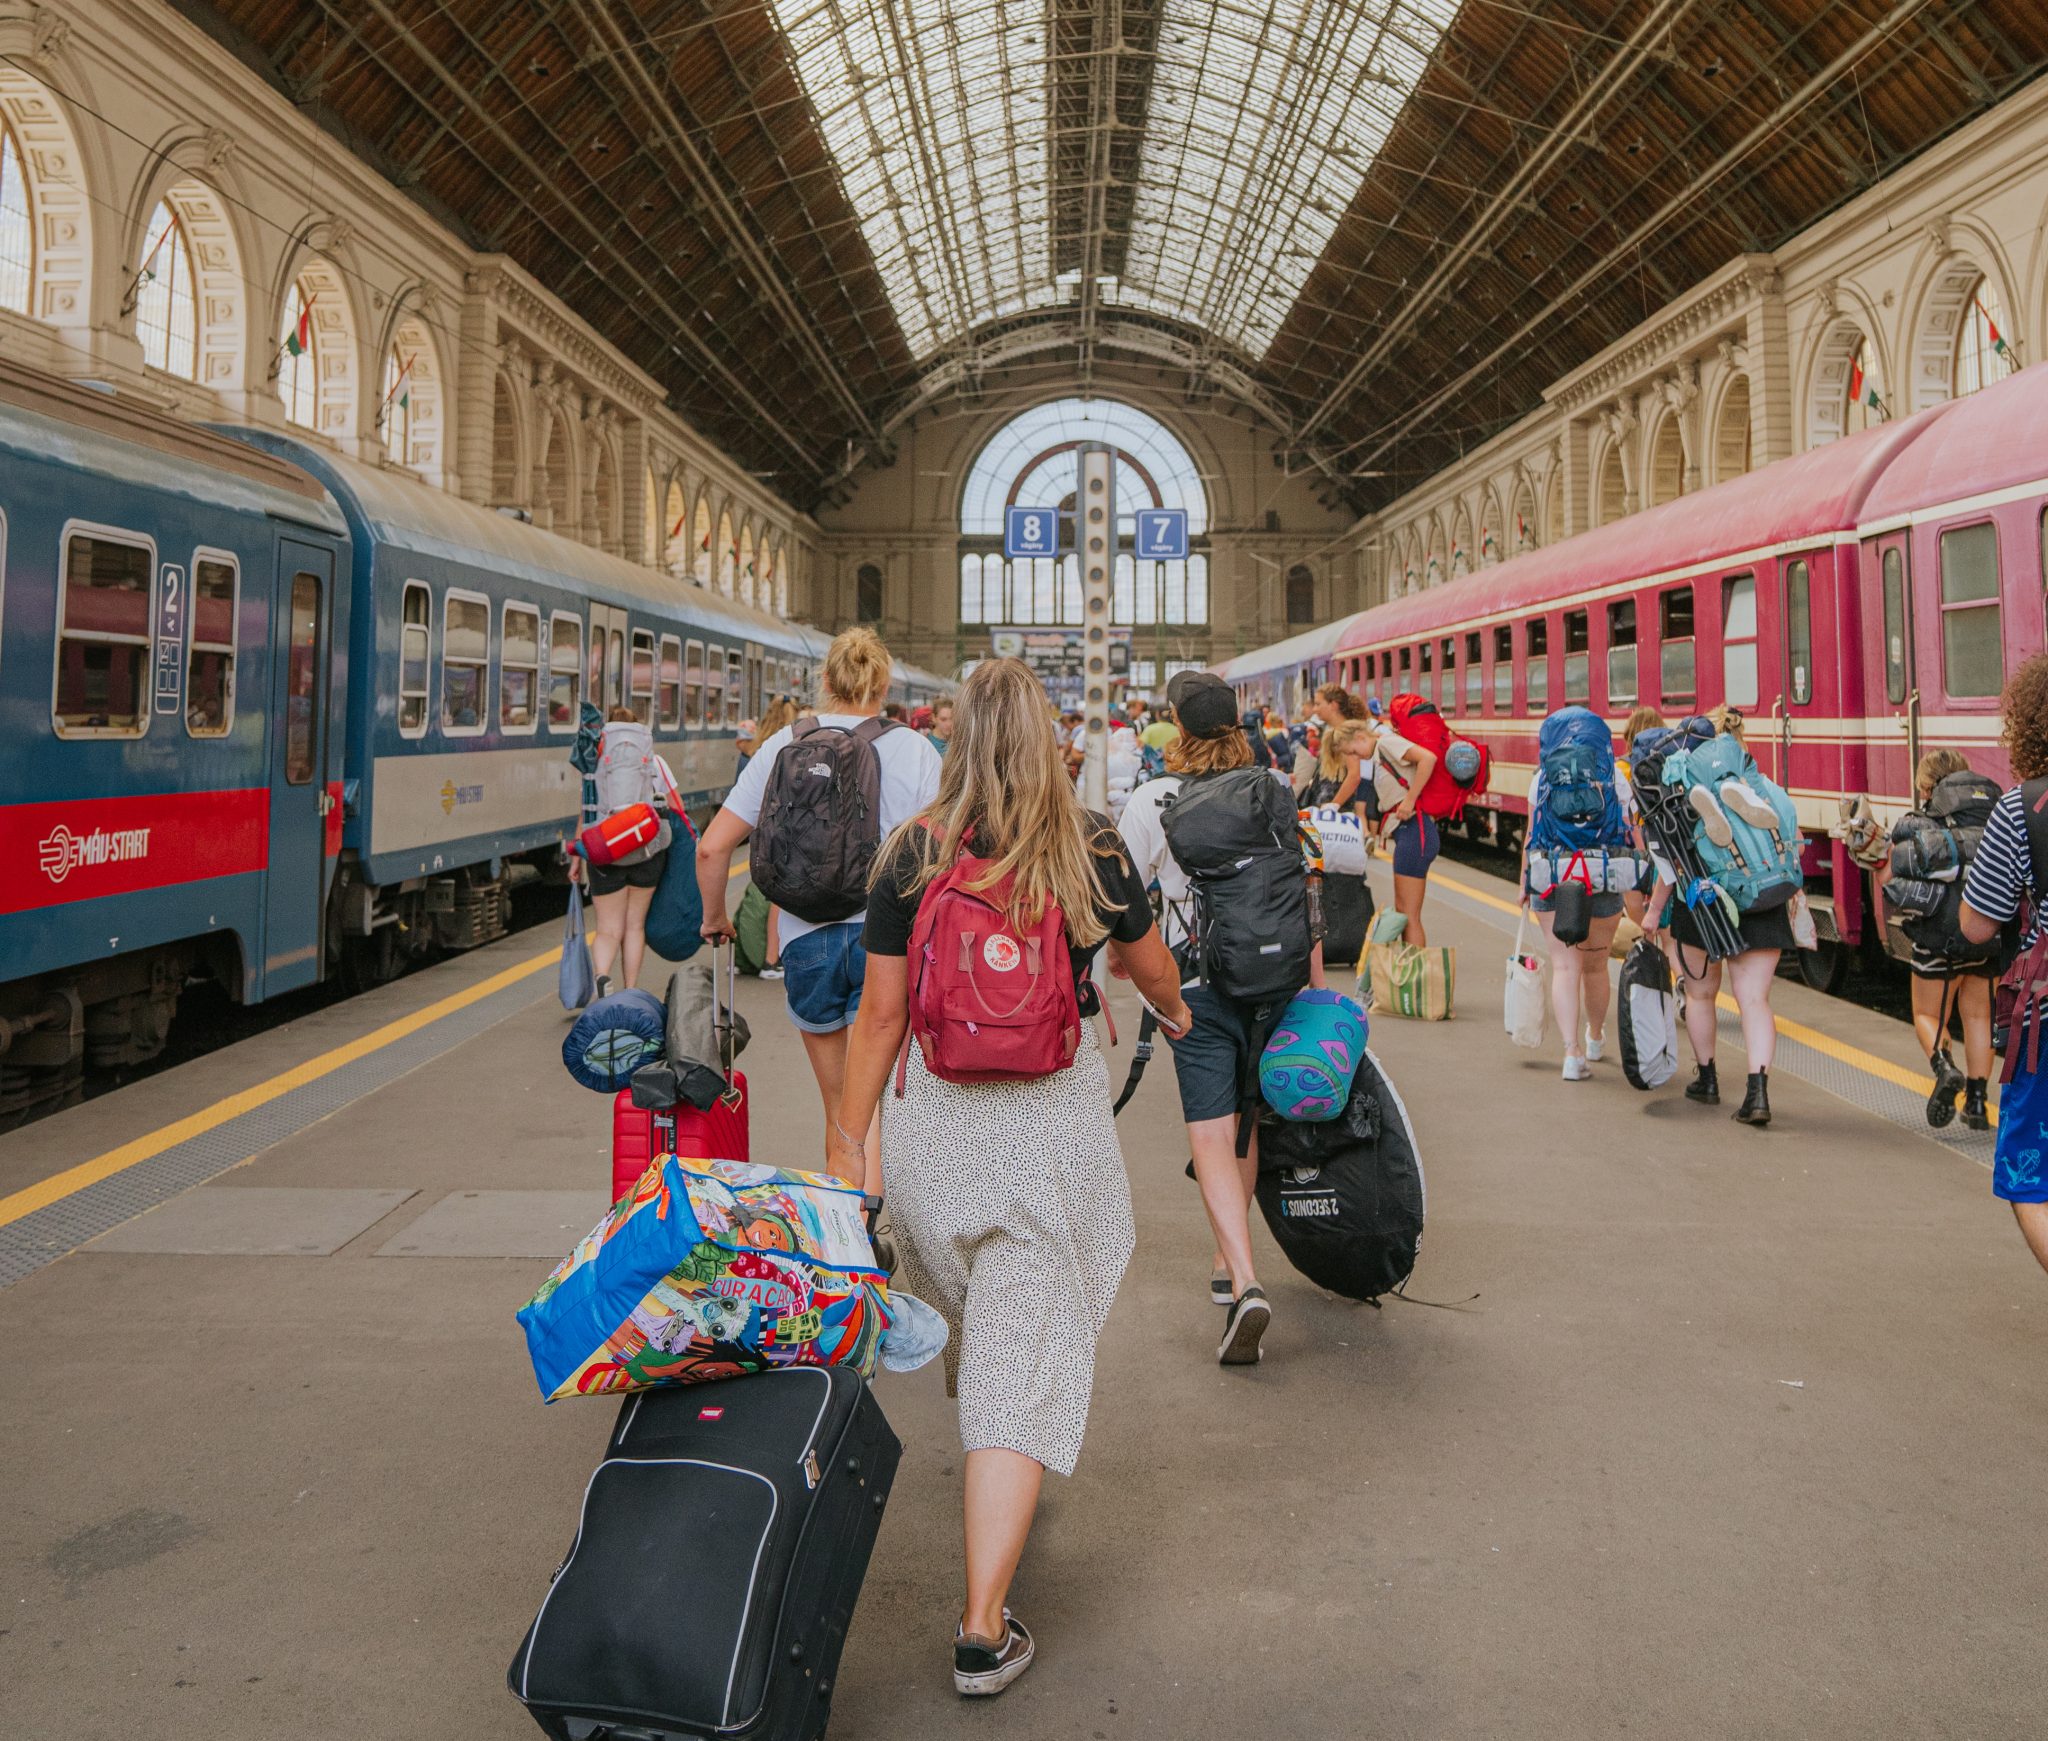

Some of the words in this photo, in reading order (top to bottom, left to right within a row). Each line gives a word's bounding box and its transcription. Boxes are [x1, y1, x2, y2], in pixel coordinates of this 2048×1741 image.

[1023, 515, 1042, 542] 8
[1152, 517, 1171, 544] 7
[165, 571, 178, 613] 2
[1281, 1199, 1289, 1217] 3
[1288, 1198, 1331, 1217] SECONDS
[1330, 1197, 1339, 1215] 2
